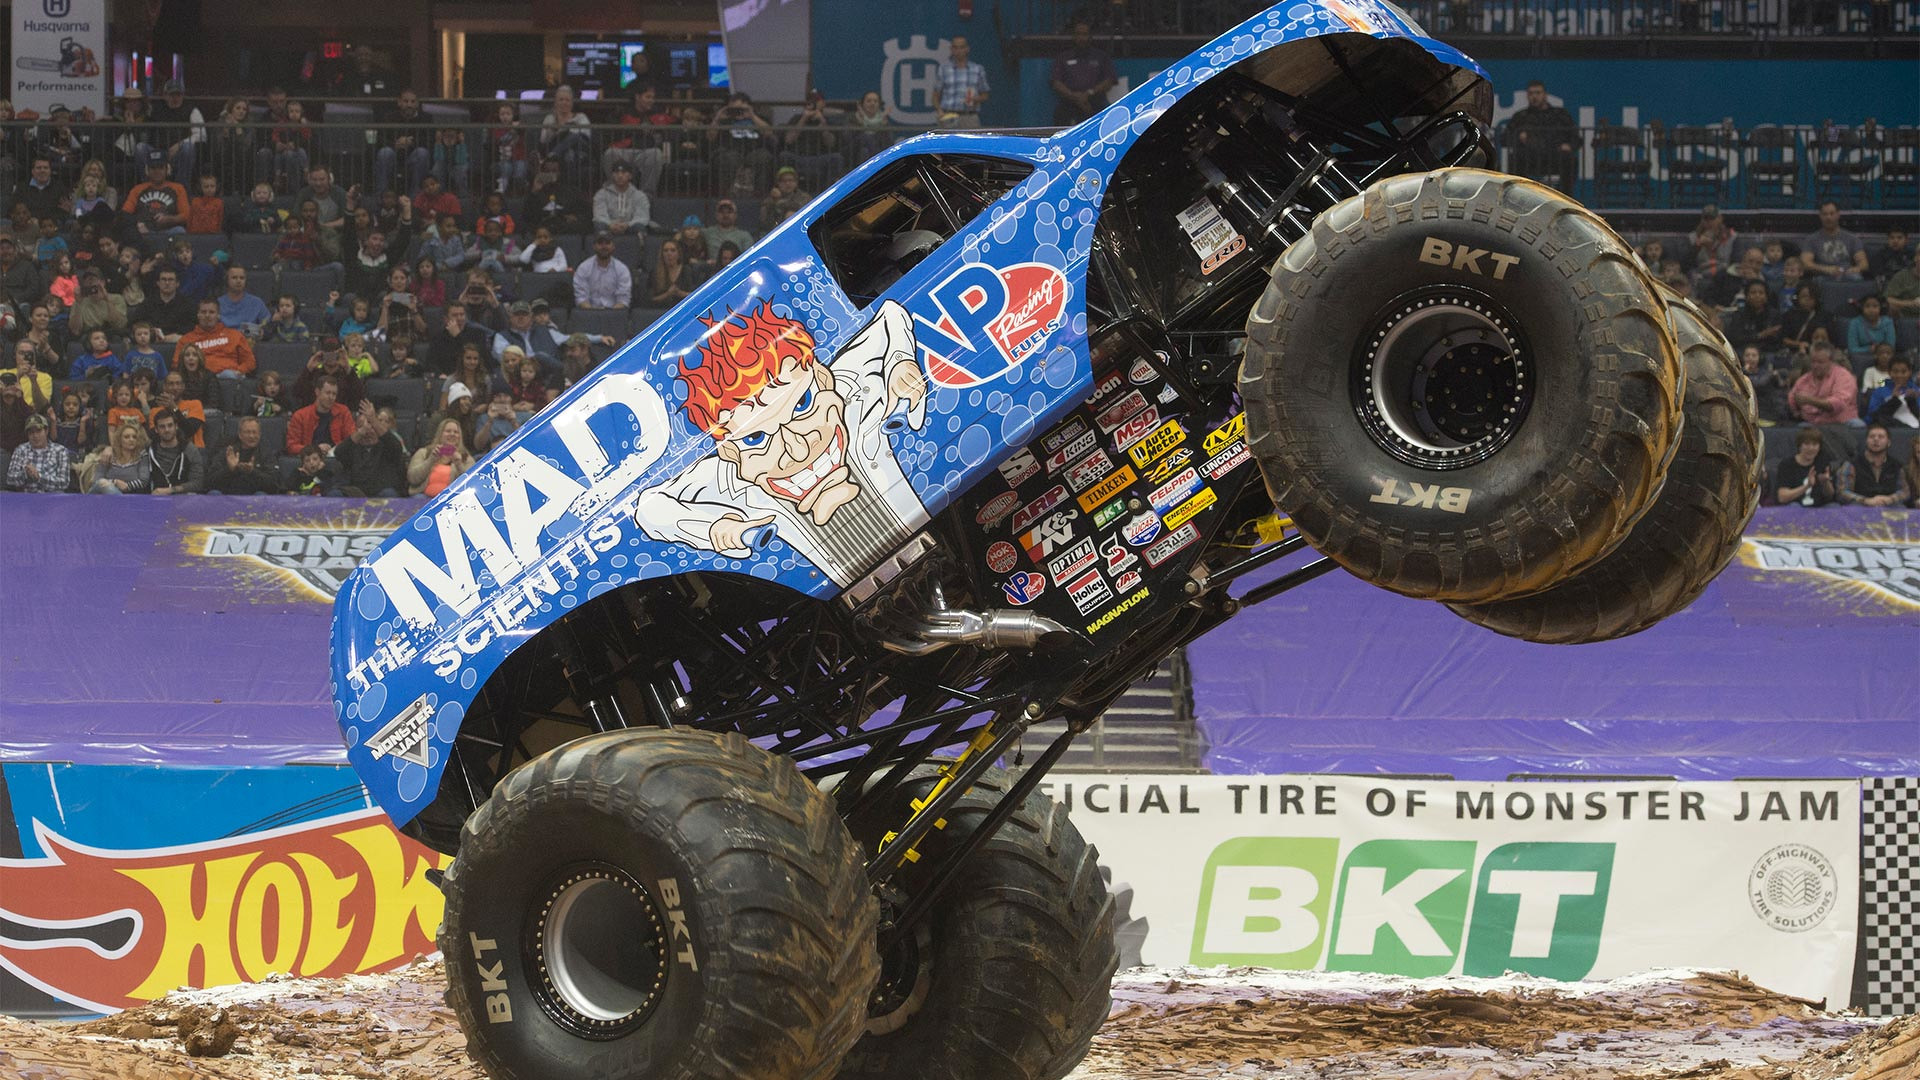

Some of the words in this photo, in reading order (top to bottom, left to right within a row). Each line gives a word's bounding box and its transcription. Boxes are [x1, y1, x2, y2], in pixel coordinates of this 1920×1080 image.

[23, 20, 91, 33] Husqvarna
[17, 81, 98, 92] Performance.
[1418, 235, 1521, 281] BKT
[912, 262, 1011, 382] VP
[995, 272, 1060, 350] Racing
[1010, 319, 1061, 360] FUELS
[1132, 365, 1151, 380] TOTAL
[1085, 376, 1122, 405] Coan
[1116, 408, 1158, 445] MSD
[1146, 426, 1171, 448] Auto
[1065, 433, 1095, 458] KING
[1147, 431, 1180, 461] Meter
[1166, 447, 1194, 470] PAC
[1201, 443, 1243, 475] LINCOLN
[1010, 463, 1040, 488] SIMPSON
[1072, 452, 1106, 479] FK
[1075, 464, 1111, 490] ENDS
[1080, 460, 1108, 481] ROD
[1215, 450, 1251, 476] WELDERS
[371, 373, 672, 631] MAD
[1085, 472, 1129, 505] TIMKEN
[1150, 470, 1195, 505] FEL-PRO
[1369, 477, 1473, 514] BKT
[1014, 486, 1064, 530] ARP
[1094, 499, 1123, 527] BKT
[1166, 500, 1194, 522] ENERGY
[1031, 508, 1078, 557] K&N
[1131, 516, 1154, 537] LUCAS
[1149, 526, 1191, 559] DERALE
[990, 545, 1010, 561] NGK
[1053, 542, 1092, 575] OPTIMA
[429, 497, 642, 677] SCIENTIST
[1002, 571, 1031, 604] VP
[1073, 579, 1106, 603] Holley
[1081, 591, 1110, 612] EQUIPPED
[1086, 586, 1151, 635] MAGNAFLOW
[345, 631, 420, 693] THE
[371, 704, 436, 761] MONSTER
[397, 727, 426, 757] JAM
[1227, 784, 1337, 815] TIRE
[1365, 787, 1428, 817] OF
[1455, 791, 1706, 821] MONSTER
[1734, 791, 1839, 822] JAM
[1756, 848, 1831, 880] OFF-HIGHWAY
[114, 850, 360, 1000] HOT
[657, 877, 699, 972] BKT
[1202, 865, 1598, 960] BKT
[1754, 889, 1773, 918] TIRE
[1773, 890, 1833, 928] SOLUTIONS
[469, 931, 513, 1024] BKT
